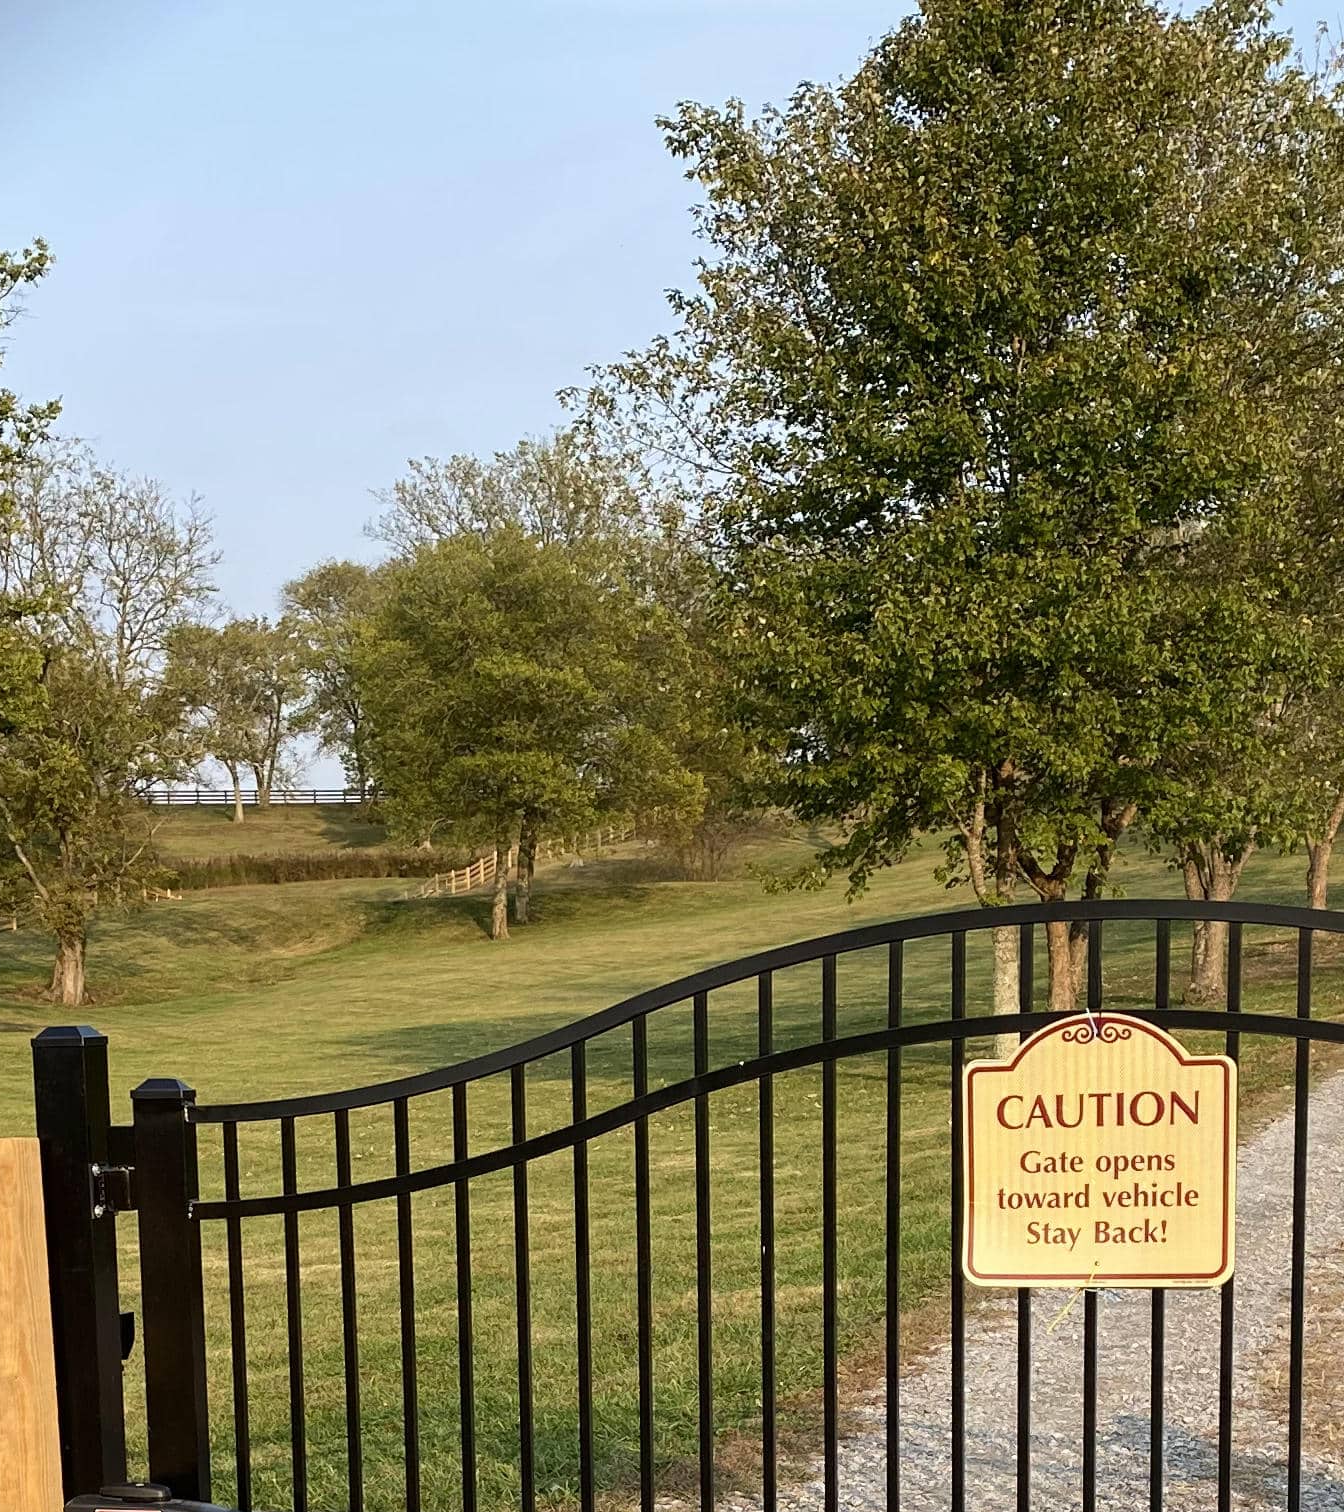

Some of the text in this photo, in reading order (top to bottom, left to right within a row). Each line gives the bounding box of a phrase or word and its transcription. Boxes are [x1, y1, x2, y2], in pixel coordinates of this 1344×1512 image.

[996, 1089, 1200, 1130] CAUTION
[1019, 1150, 1176, 1180] Gate opens
[996, 1182, 1200, 1210] toward vehicle
[1026, 1218, 1168, 1252] Stay Back!
